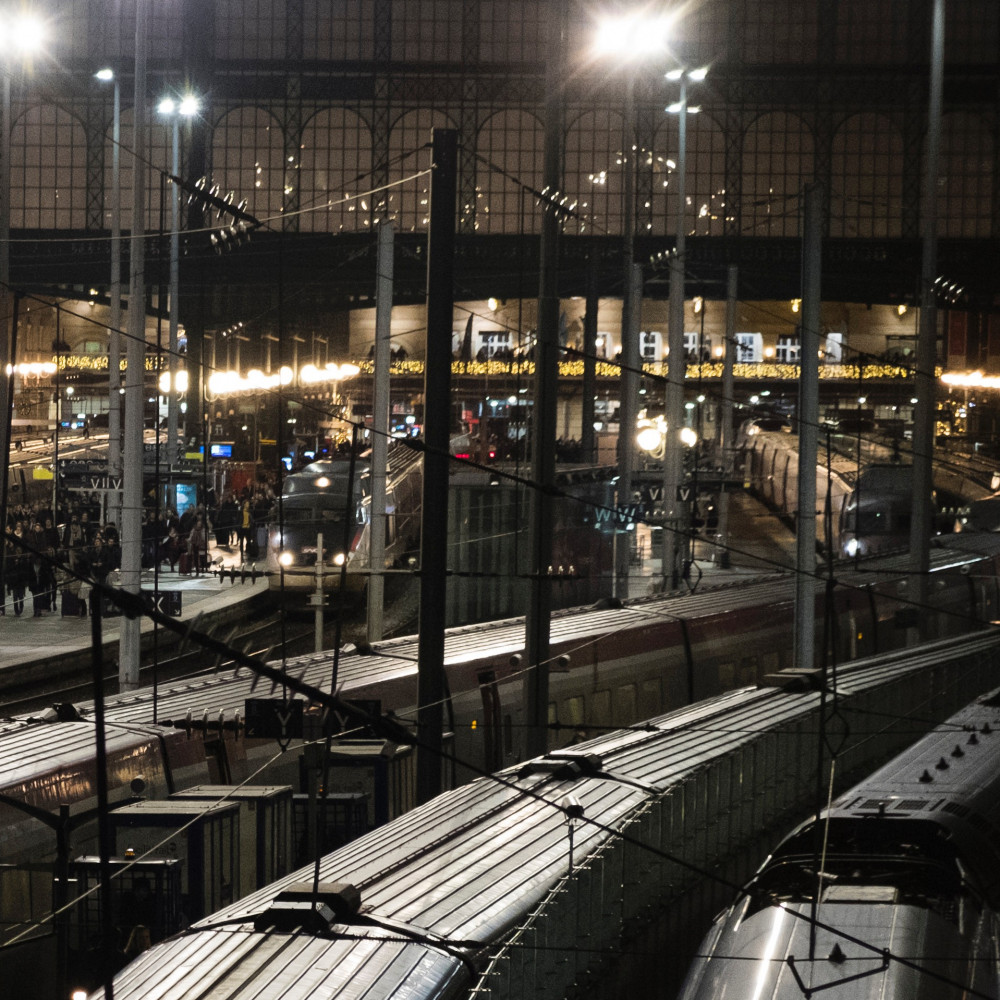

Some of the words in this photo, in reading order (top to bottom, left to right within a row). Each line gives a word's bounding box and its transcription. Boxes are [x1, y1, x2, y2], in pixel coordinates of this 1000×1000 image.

[679, 488, 690, 501] V
[594, 507, 611, 522] W
[617, 507, 636, 522] W
[273, 707, 295, 736] Y
[333, 709, 351, 734] Y
